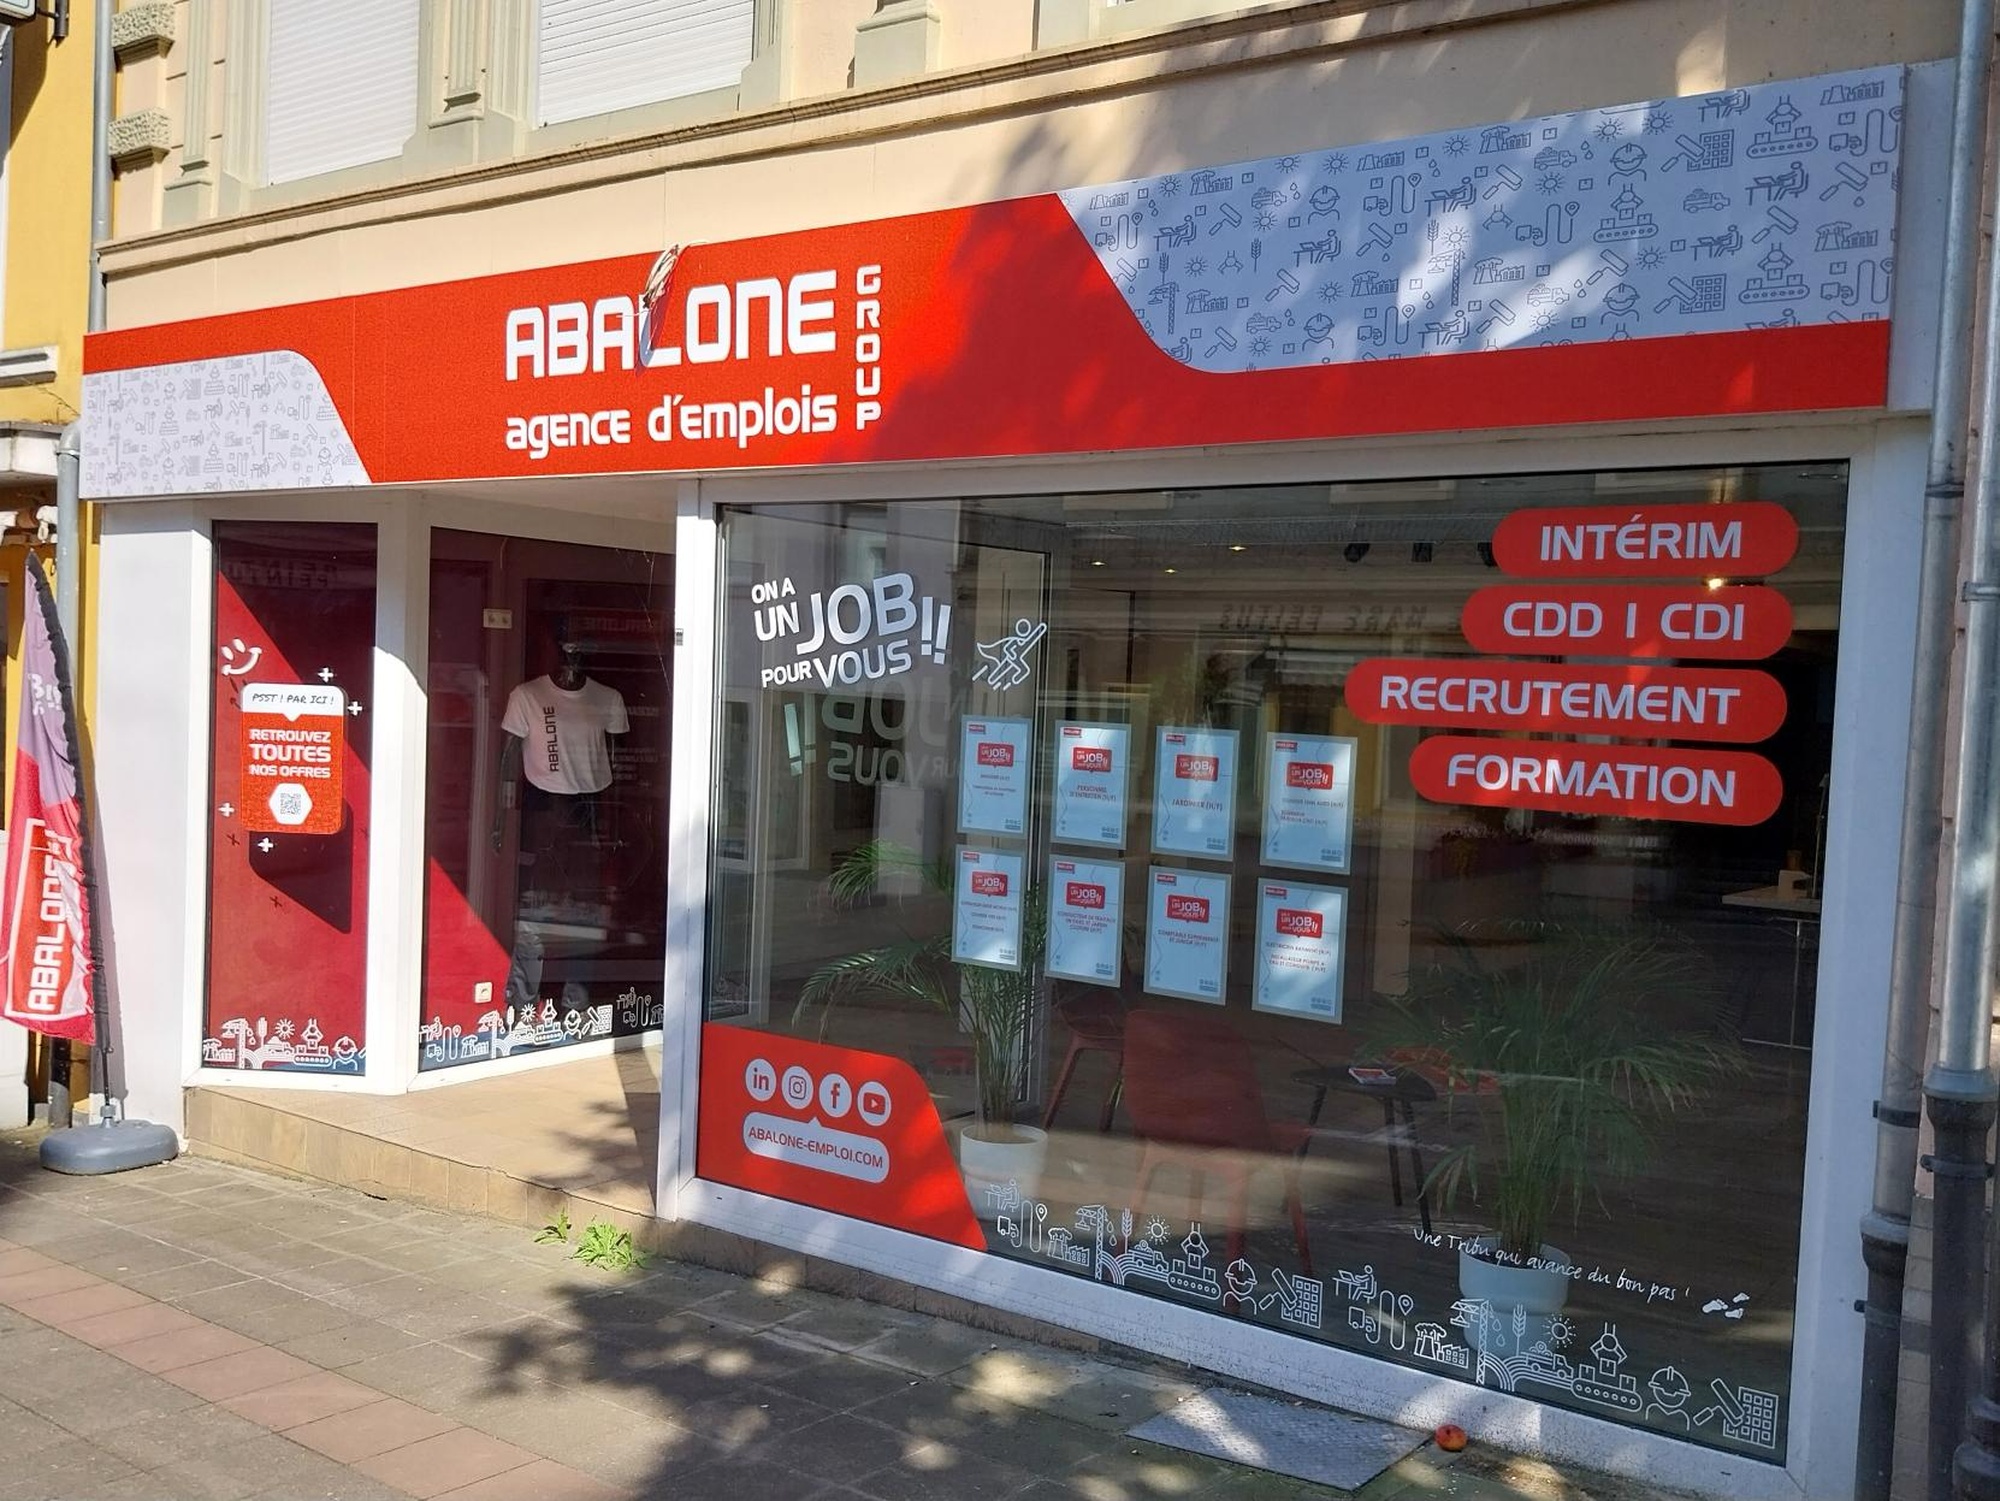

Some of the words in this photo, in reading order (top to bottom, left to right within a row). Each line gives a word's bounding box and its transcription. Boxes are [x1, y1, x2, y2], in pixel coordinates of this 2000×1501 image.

[506, 269, 837, 381] ABALONE
[855, 264, 882, 431] GROUP
[506, 409, 631, 460] agence
[1540, 514, 1742, 561] INTÉRIM
[751, 580, 778, 604] ON
[781, 577, 796, 597] A
[754, 601, 800, 641] UN
[1503, 601, 1603, 638] CDD
[1660, 602, 1745, 641] CDI
[761, 659, 813, 688] POUR
[812, 639, 913, 689] VOUS
[287, 694, 306, 704] PAR
[1380, 675, 1741, 725] RECRUTEMENT
[249, 728, 332, 744] RETROUVEZ
[249, 743, 332, 763] TOUTES
[543, 706, 560, 772] ABALONE
[249, 764, 278, 776] NOS
[280, 765, 331, 779] OFFRES
[1446, 753, 1737, 807] FORMATION
[748, 1126, 883, 1168] ABALONE-EMPLOI.COM
[1413, 1228, 1441, 1247] Une
[1447, 1234, 1491, 1256] Tribu
[1495, 1248, 1523, 1269] qui
[1527, 1255, 1583, 1279] avance
[1587, 1266, 1612, 1285] du
[1616, 1269, 1646, 1294] bon
[1648, 1280, 1677, 1304] pas
